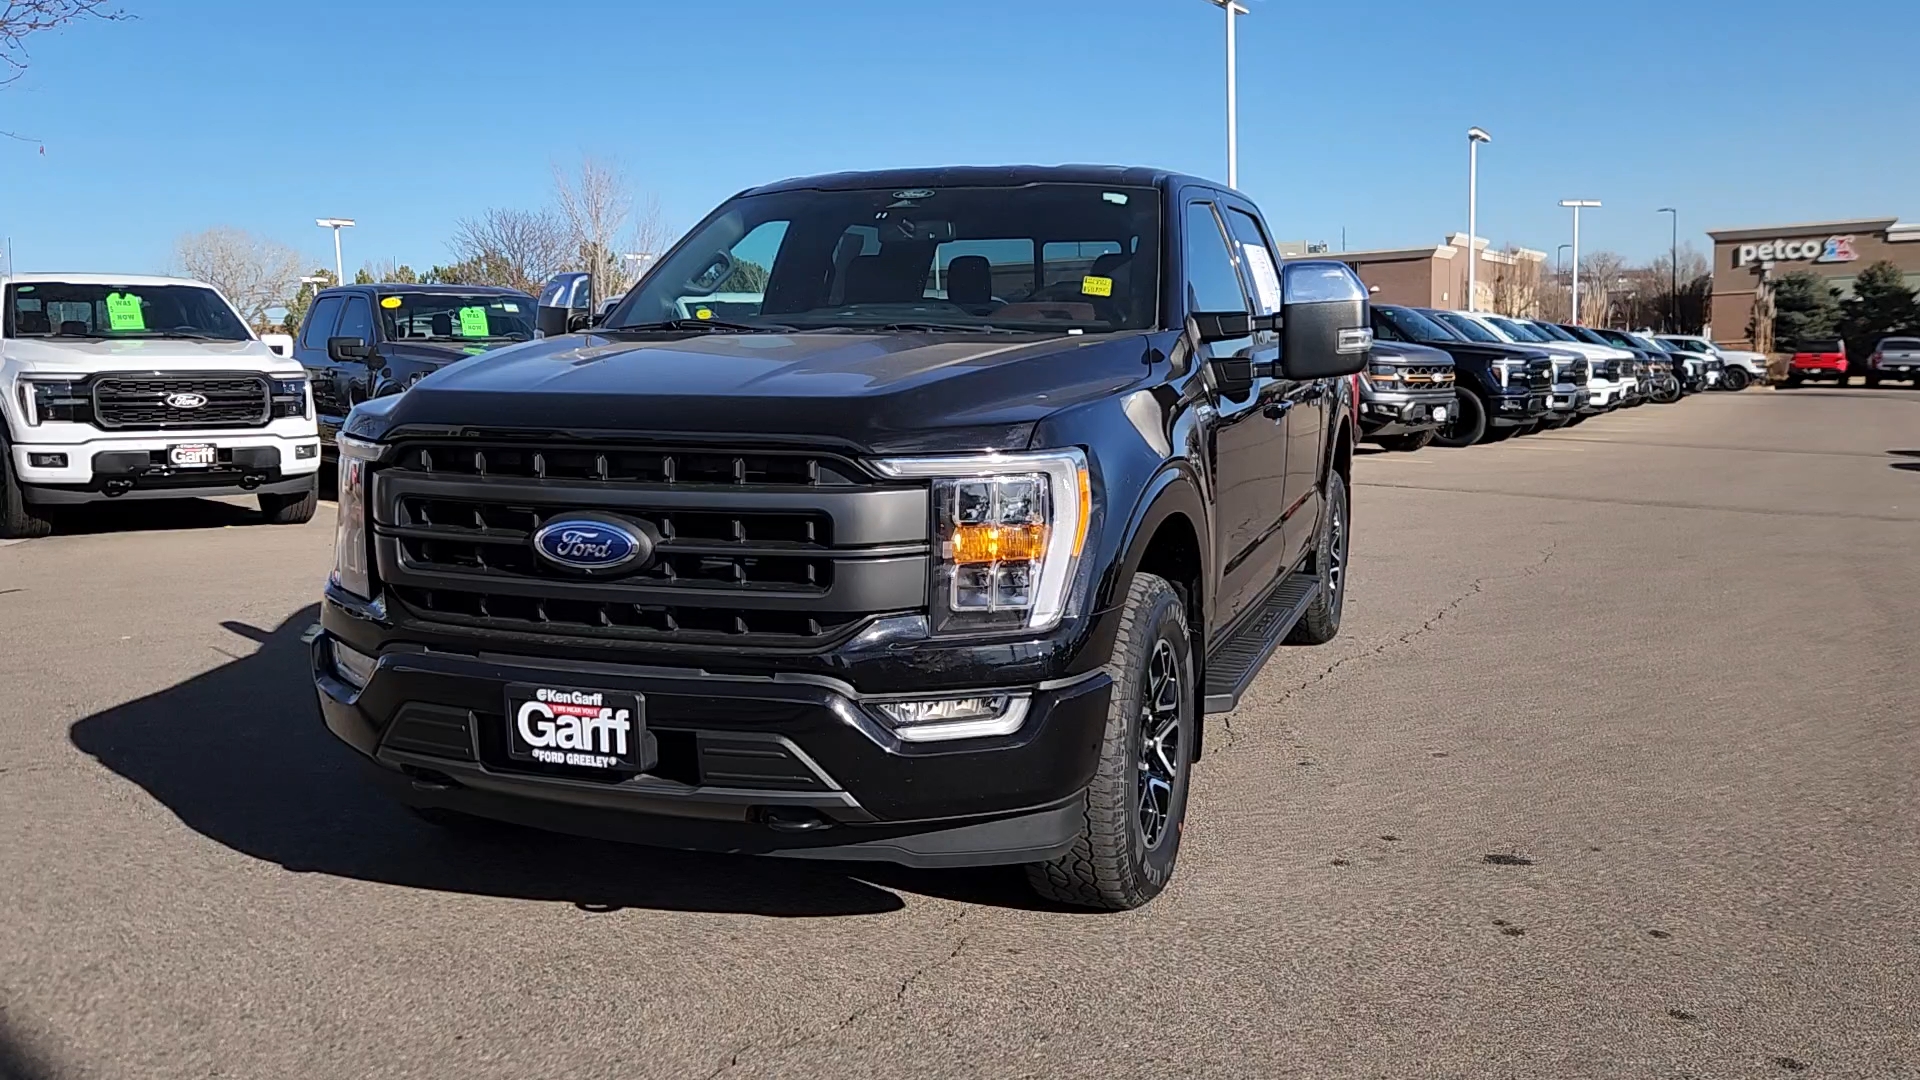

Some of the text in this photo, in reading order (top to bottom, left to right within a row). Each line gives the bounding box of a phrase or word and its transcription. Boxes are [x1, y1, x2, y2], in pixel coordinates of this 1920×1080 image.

[1739, 239, 1821, 266] petco
[174, 395, 200, 406] Ford
[170, 447, 215, 464] Garff
[556, 530, 612, 557] Ford
[517, 701, 630, 755] Garff
[539, 750, 609, 768] FORD GREELEY
